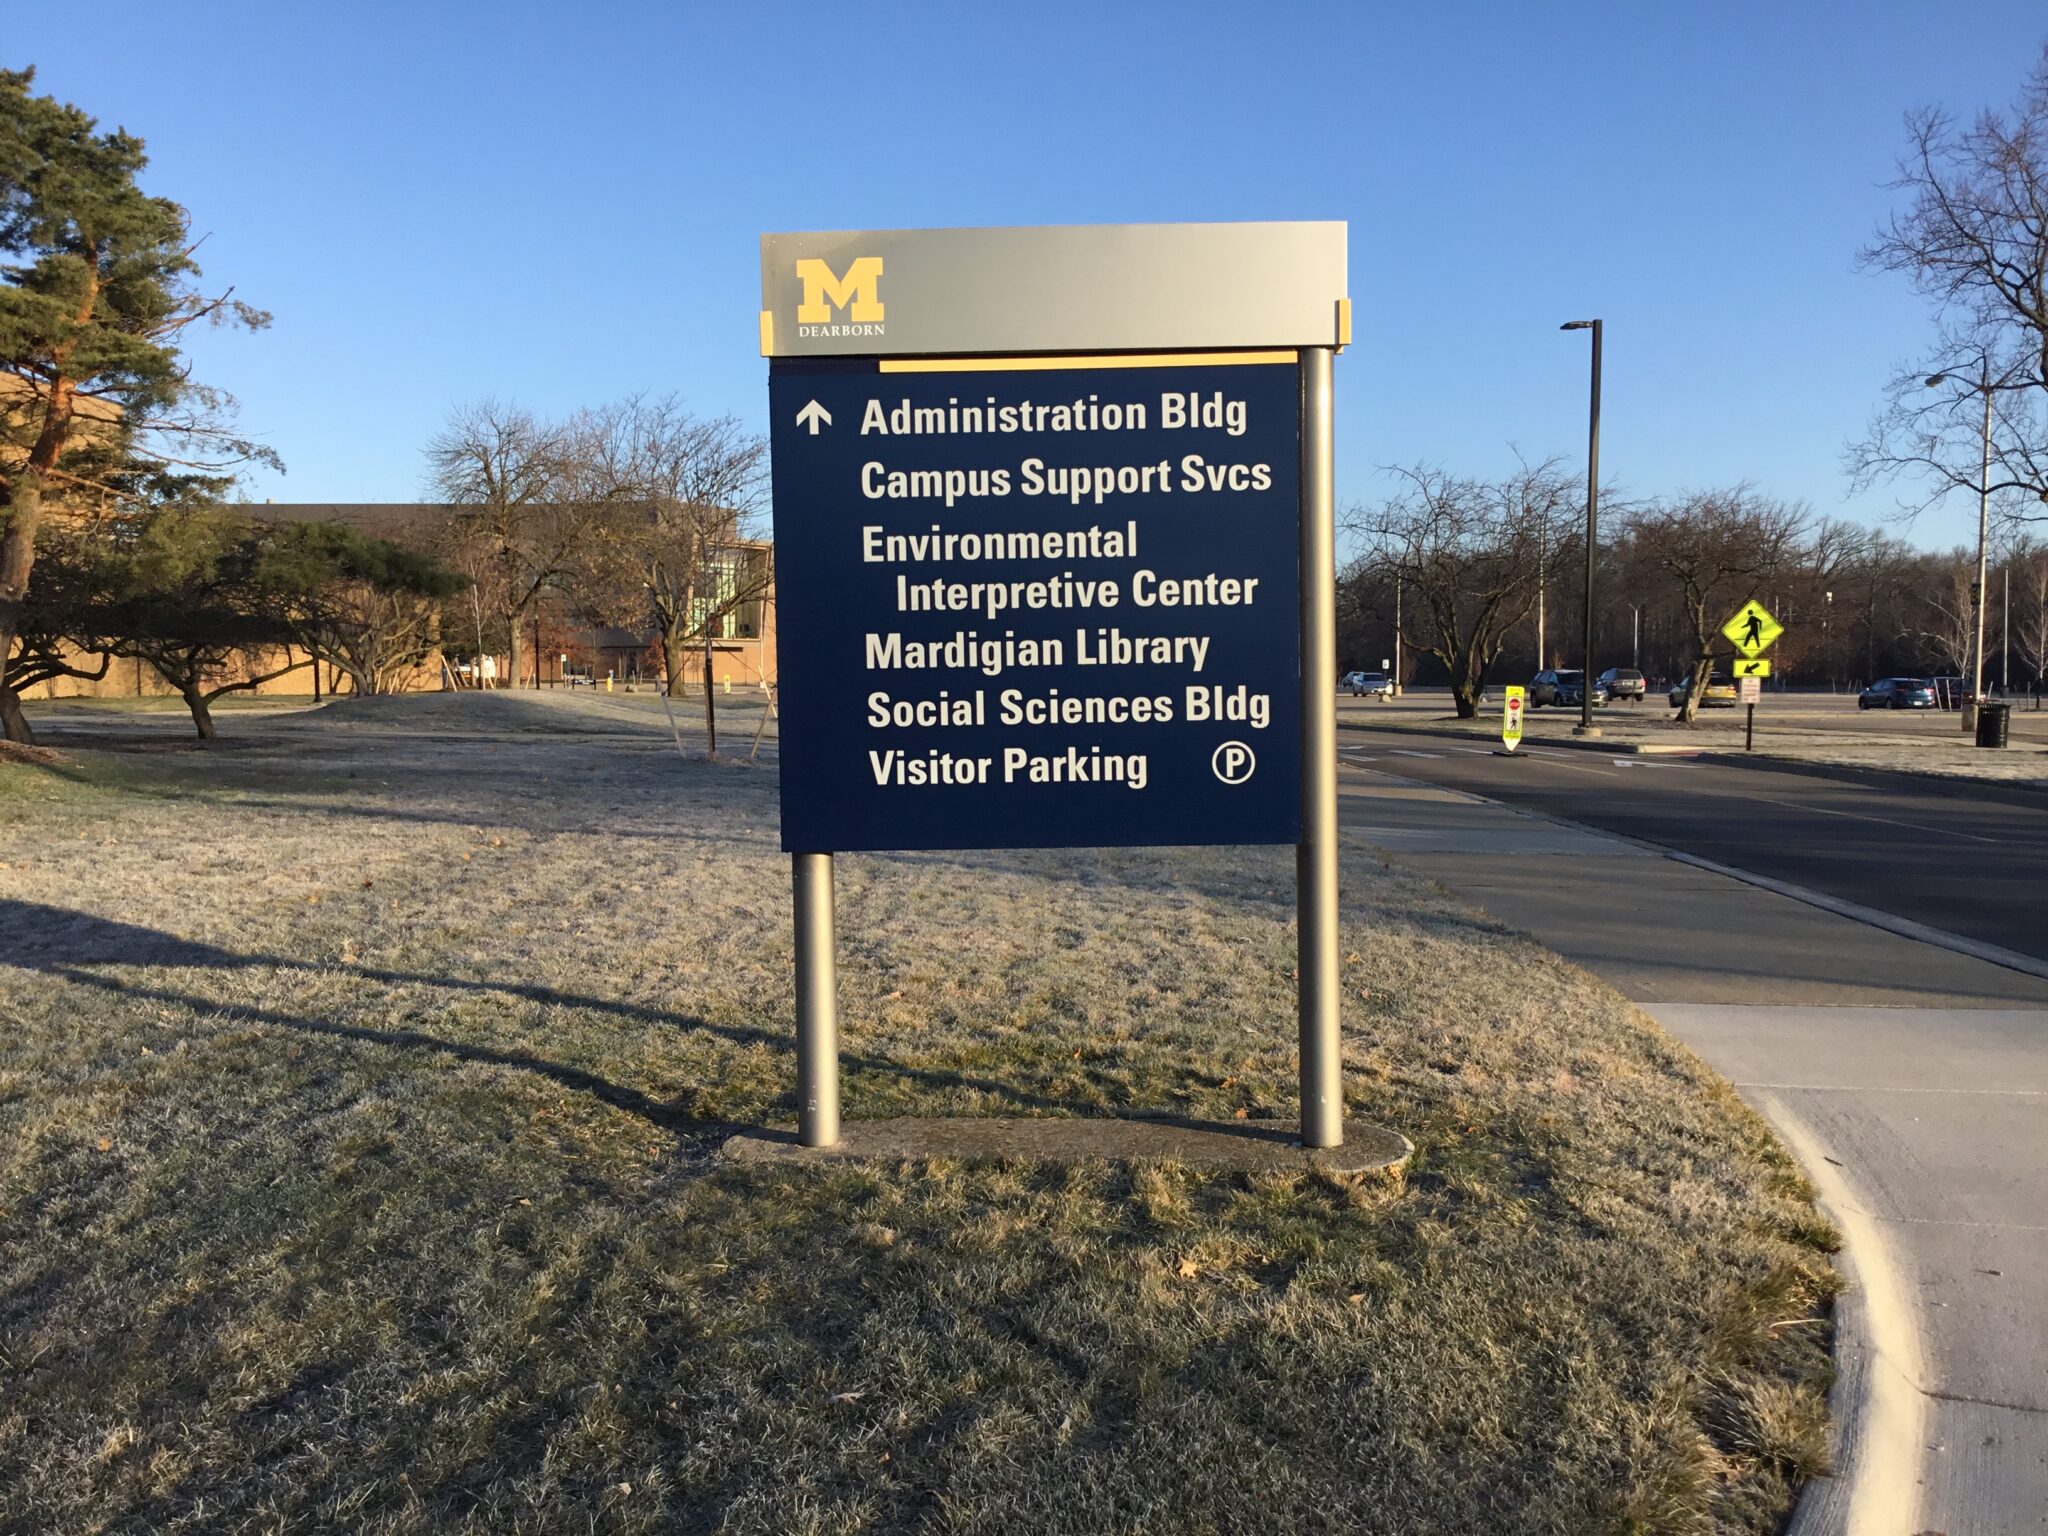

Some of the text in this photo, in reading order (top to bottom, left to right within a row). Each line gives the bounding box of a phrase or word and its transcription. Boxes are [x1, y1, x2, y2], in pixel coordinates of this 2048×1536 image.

[796, 257, 885, 323] M
[799, 325, 885, 337] DEARBORN
[860, 391, 1247, 436] Administration Bldg
[862, 455, 1272, 508] Campus Support Svcs
[863, 521, 1137, 563] Environmental
[897, 570, 1259, 620] Interpretive Center
[866, 628, 1210, 676] Mardigian Library
[868, 685, 1270, 729] Social Sciences Bldg
[869, 746, 1147, 790] Visitor Parking
